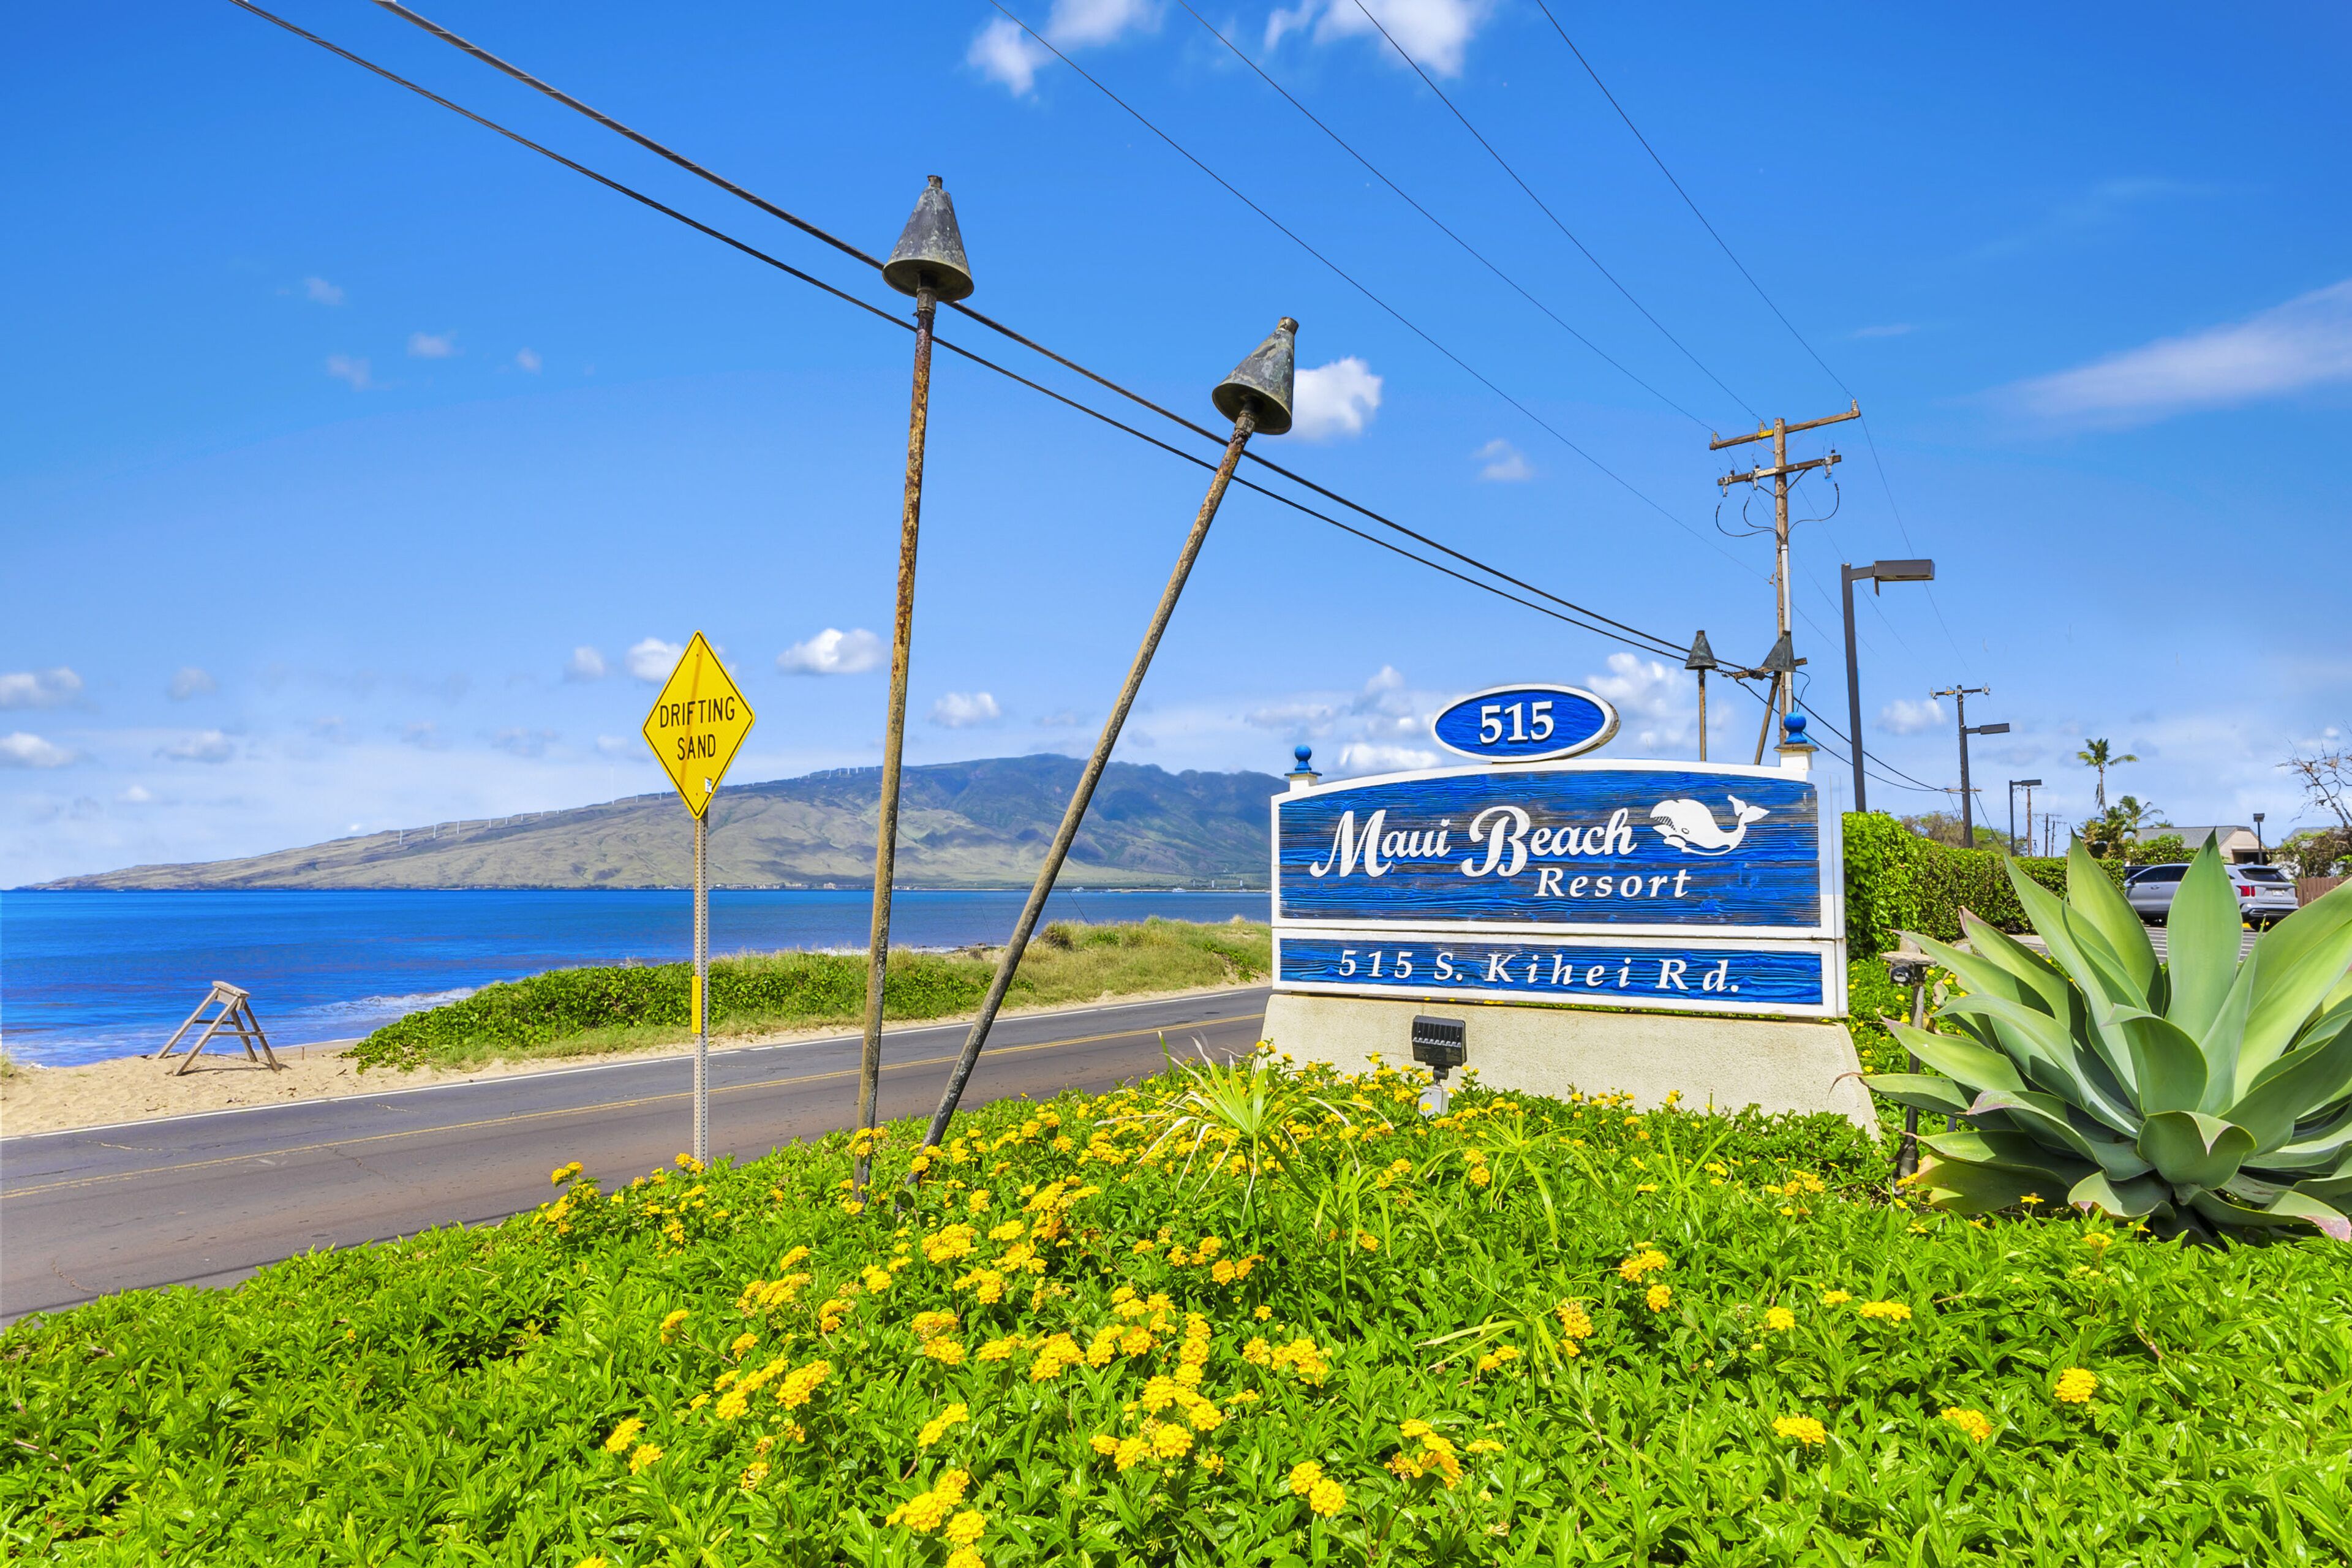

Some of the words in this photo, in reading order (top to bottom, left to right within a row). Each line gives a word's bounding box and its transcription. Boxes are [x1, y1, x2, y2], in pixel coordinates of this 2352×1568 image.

[660, 696, 735, 728] DRIFTING
[1479, 700, 1555, 744] 515
[677, 734, 716, 761] SAND
[1309, 809, 1450, 878] Maui
[1461, 805, 1638, 877] Beach
[1534, 868, 1692, 898] Resort
[1339, 949, 1414, 978] 515
[1434, 952, 1463, 981] S.
[1484, 953, 1632, 988] Kihei
[1655, 958, 1741, 993] Rd.
